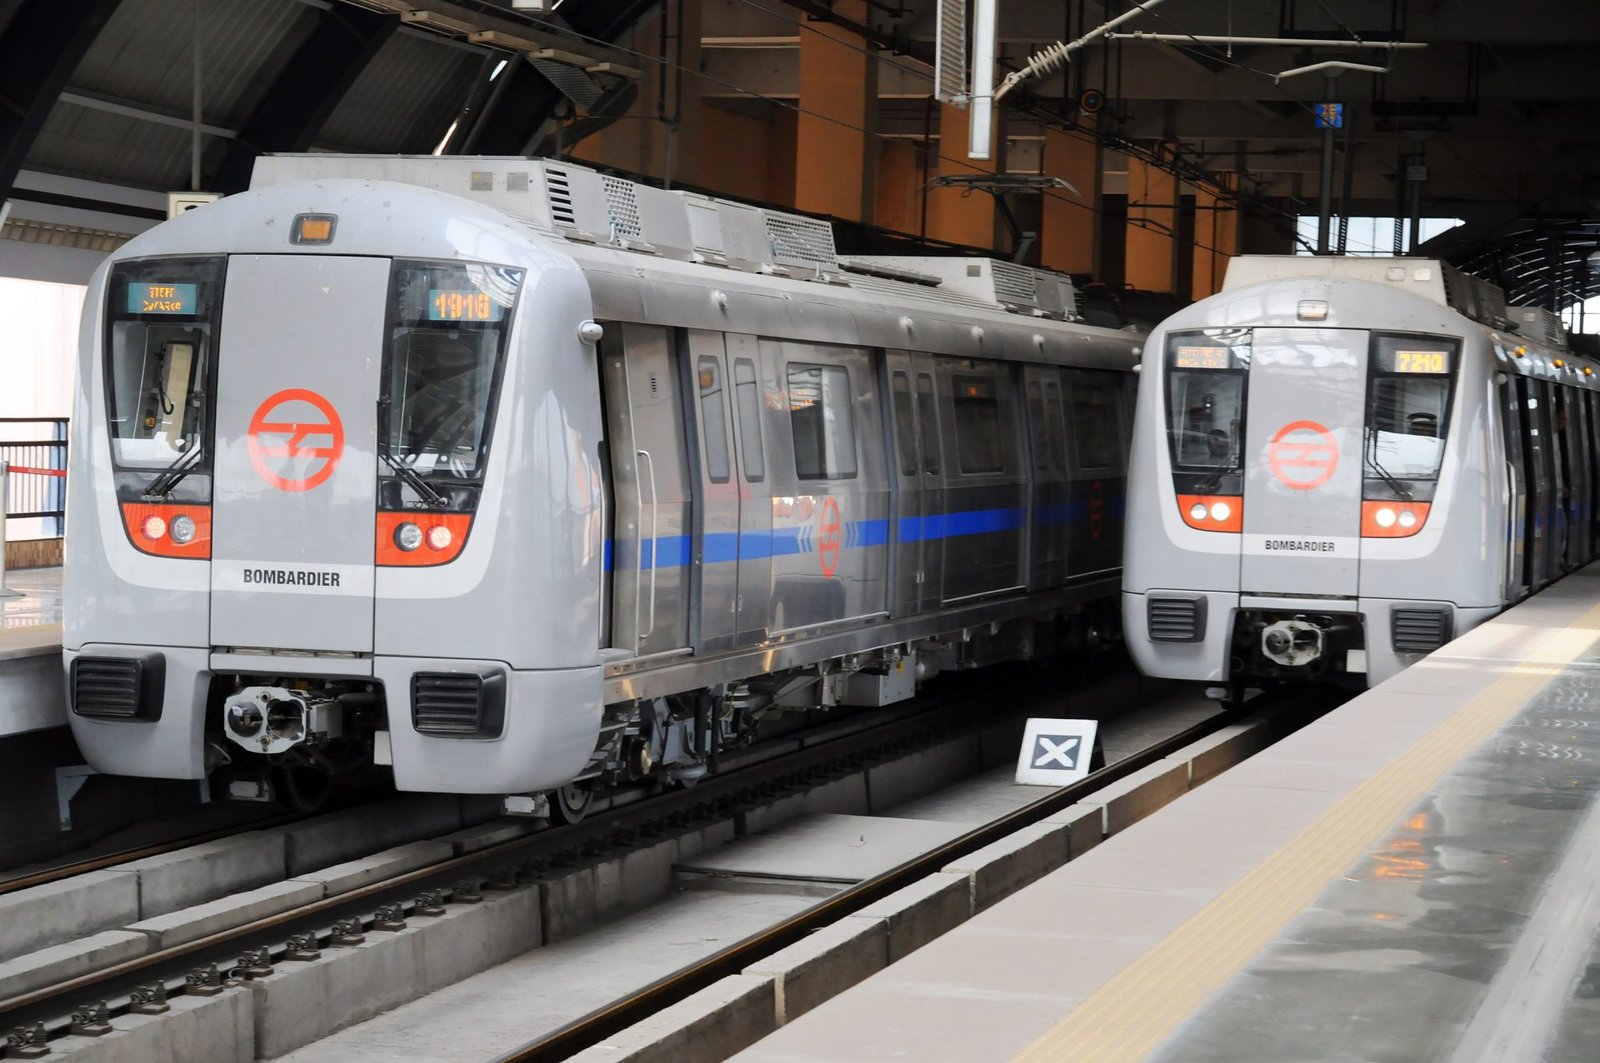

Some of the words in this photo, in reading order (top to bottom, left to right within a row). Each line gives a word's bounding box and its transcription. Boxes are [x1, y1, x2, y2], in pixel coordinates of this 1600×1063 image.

[435, 293, 490, 319] 1916
[1399, 353, 1443, 372] 7210
[1265, 540, 1336, 552] BOMBARDIER
[243, 569, 340, 587] BOMBARDIER
